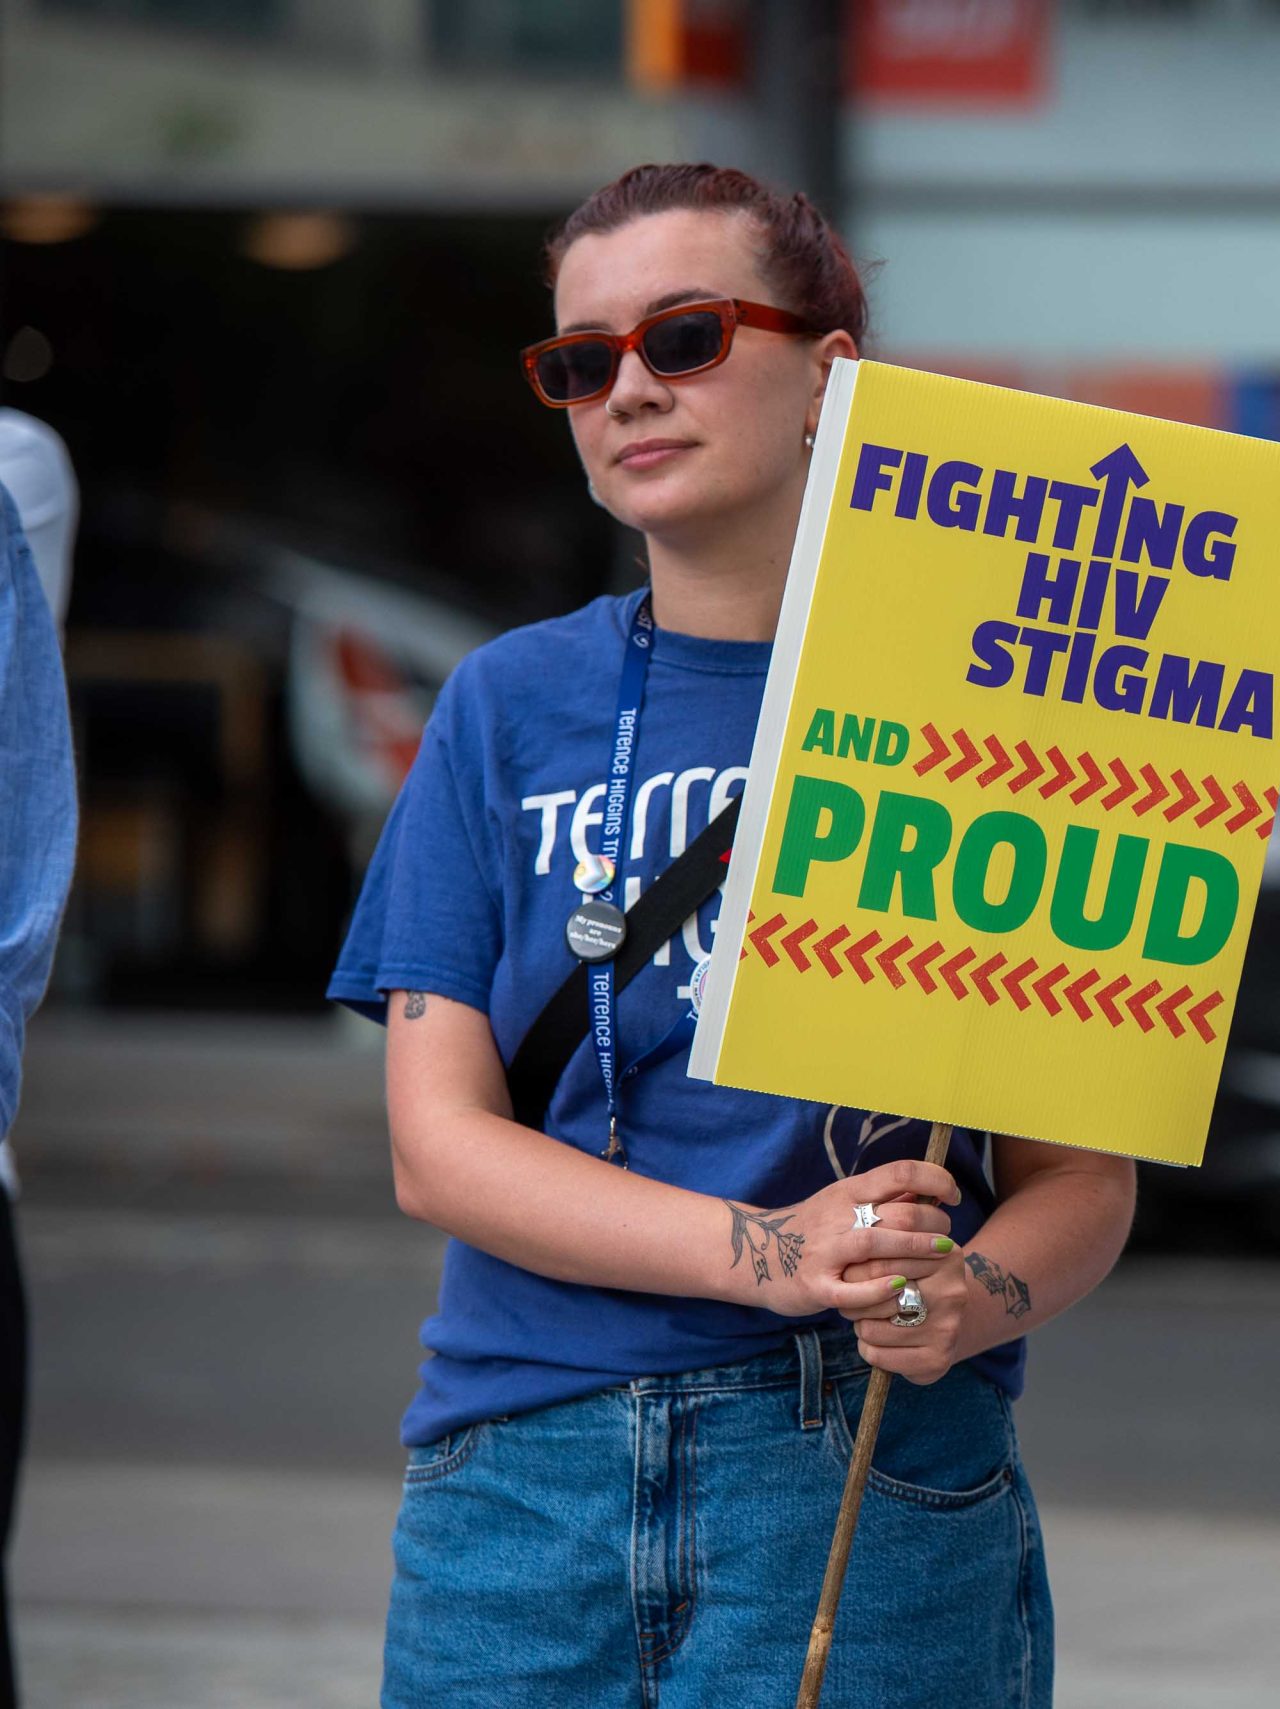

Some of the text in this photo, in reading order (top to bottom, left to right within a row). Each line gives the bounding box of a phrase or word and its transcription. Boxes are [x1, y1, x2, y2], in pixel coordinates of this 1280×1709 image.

[850, 443, 1237, 580] FIGHTING
[1016, 553, 1171, 641] HIV
[802, 708, 910, 767] AND
[966, 620, 1274, 740] STIGMA
[772, 774, 1240, 967] PROUD
